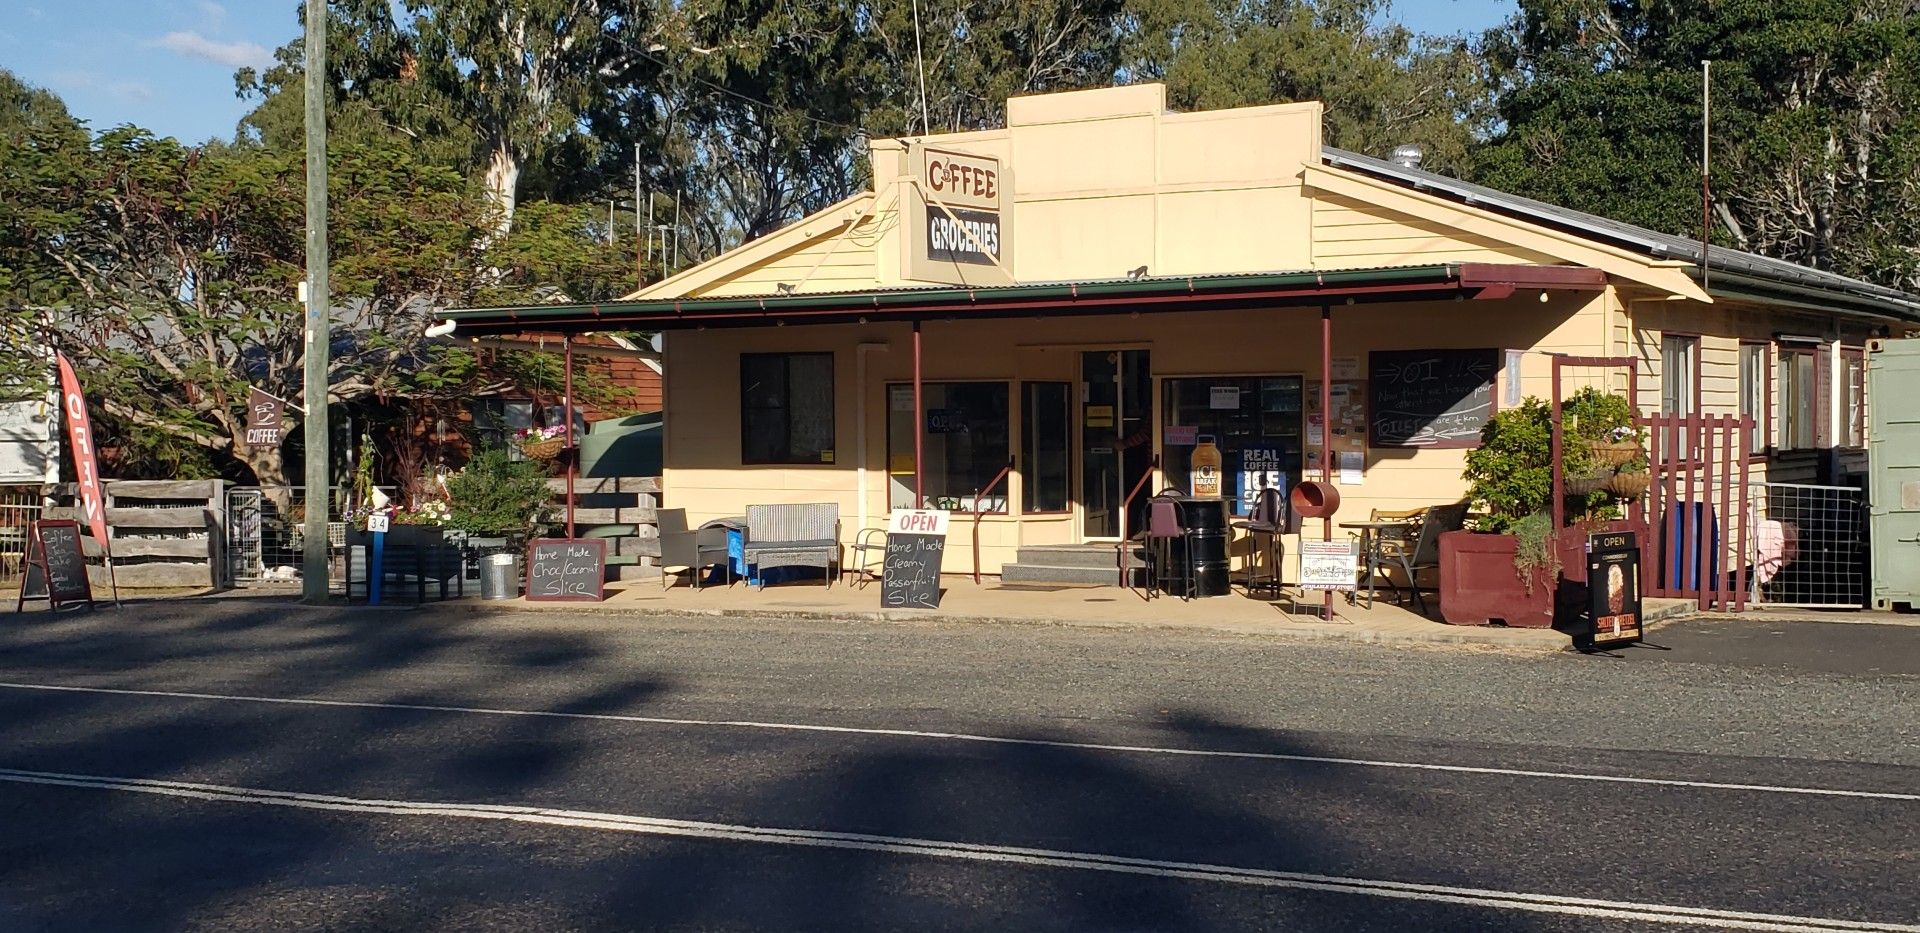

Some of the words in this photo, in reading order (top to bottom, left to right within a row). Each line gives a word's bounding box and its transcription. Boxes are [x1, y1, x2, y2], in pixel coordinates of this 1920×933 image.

[931, 216, 998, 255] GROCERIES
[247, 429, 278, 443] COFFEE
[1243, 449, 1279, 461] REAL
[1196, 465, 1217, 478] ICE
[1243, 462, 1278, 470] COFFEE
[1244, 471, 1280, 491] ICE
[900, 515, 937, 531] OPEN
[887, 536, 912, 553] Home
[917, 538, 943, 551] Made
[1604, 537, 1625, 547] OPEN
[535, 546, 558, 560] Home
[567, 546, 591, 557] Made
[885, 554, 926, 577] Creamy
[884, 568, 937, 591] Passionfruit
[542, 579, 599, 598] Slice
[887, 590, 938, 609] Slice
